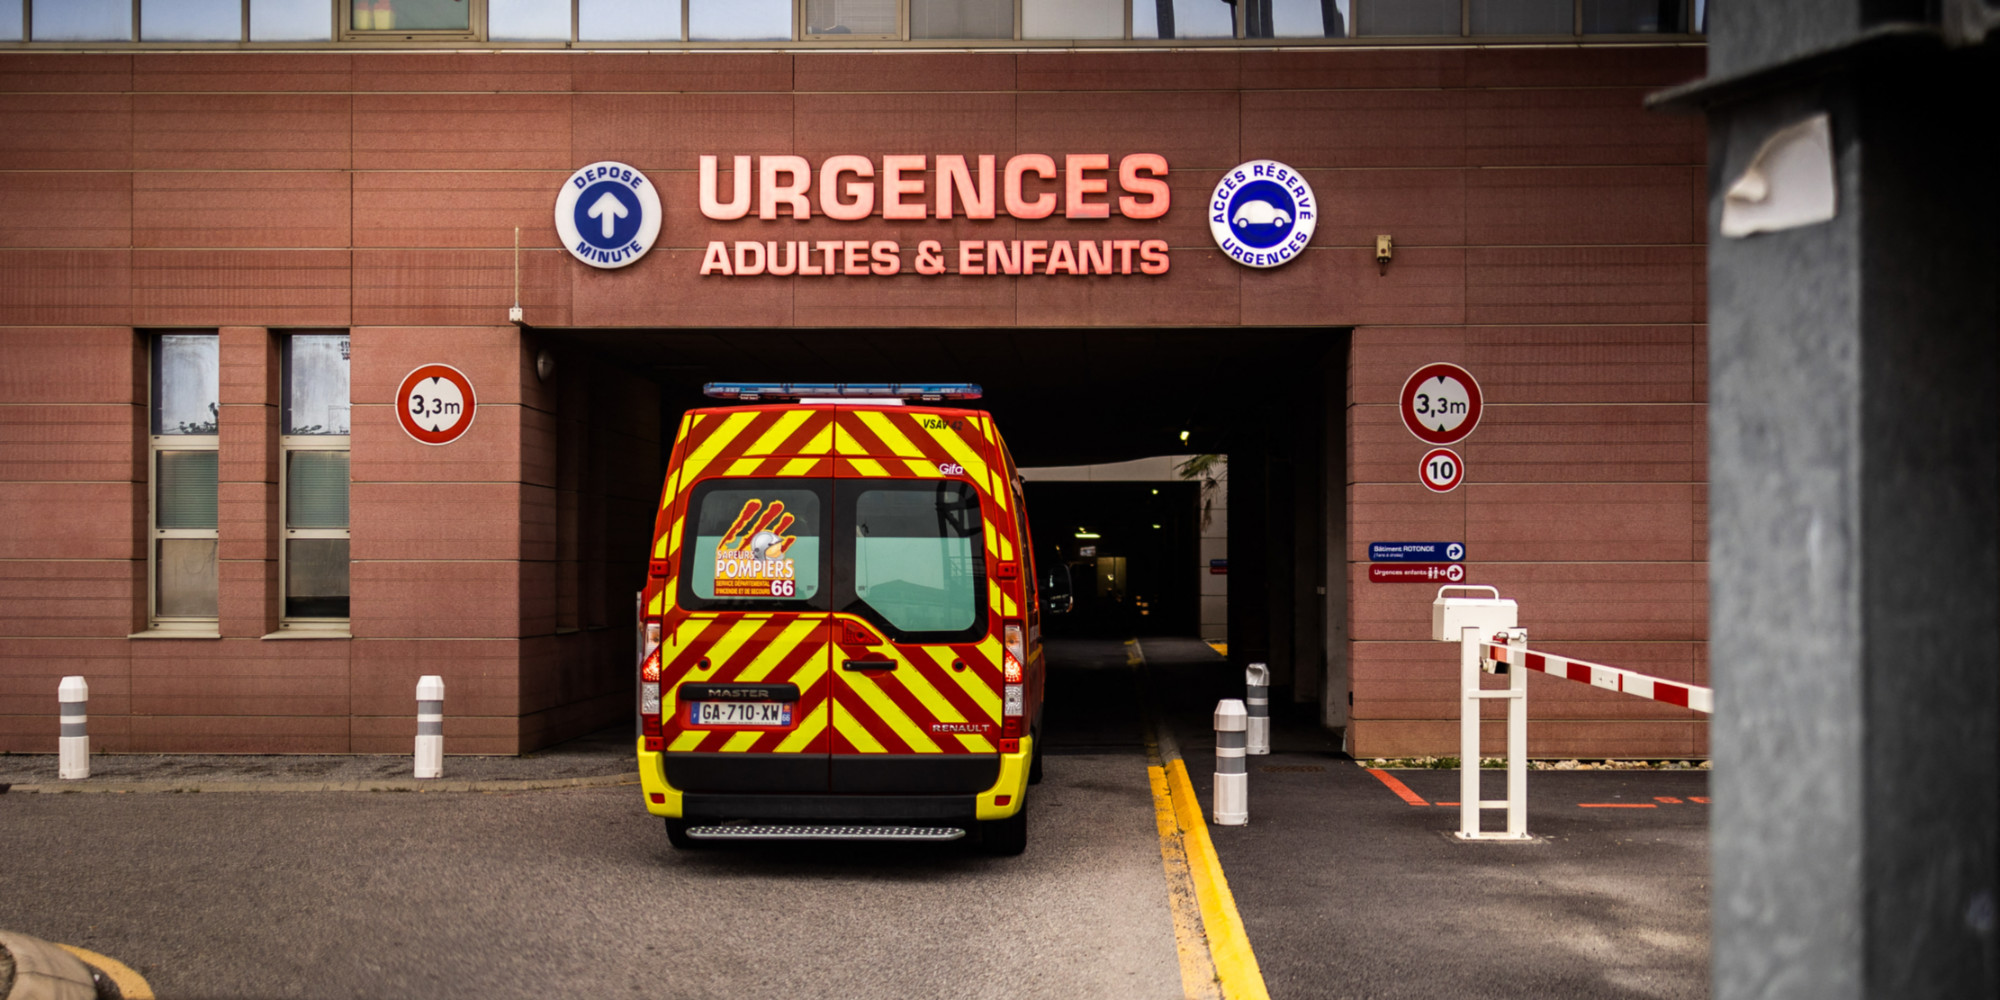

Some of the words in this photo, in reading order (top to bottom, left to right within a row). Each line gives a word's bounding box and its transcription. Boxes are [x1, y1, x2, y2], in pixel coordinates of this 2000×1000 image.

[573, 166, 643, 189] DEPOSE
[699, 153, 1171, 221] URGENCES
[1212, 170, 1247, 224] ACCÈS
[1252, 162, 1314, 221] RÉSERVÉ
[575, 240, 643, 263] MINUTE
[1222, 231, 1308, 266] URGENCES
[700, 240, 901, 276] ADULTES
[914, 240, 947, 276] &
[959, 239, 1170, 275] ENFANTS
[923, 418, 950, 430] VSAV
[938, 462, 964, 475] Gifa
[1429, 461, 1454, 479] 10
[717, 551, 756, 560] SAPEURS
[715, 559, 794, 579] POMPIERS
[1374, 569, 1403, 577] Urgences
[771, 580, 794, 596] 66
[708, 689, 769, 698] MASTER
[702, 704, 780, 720] GA-710-XW
[932, 723, 990, 733] RENAULT
